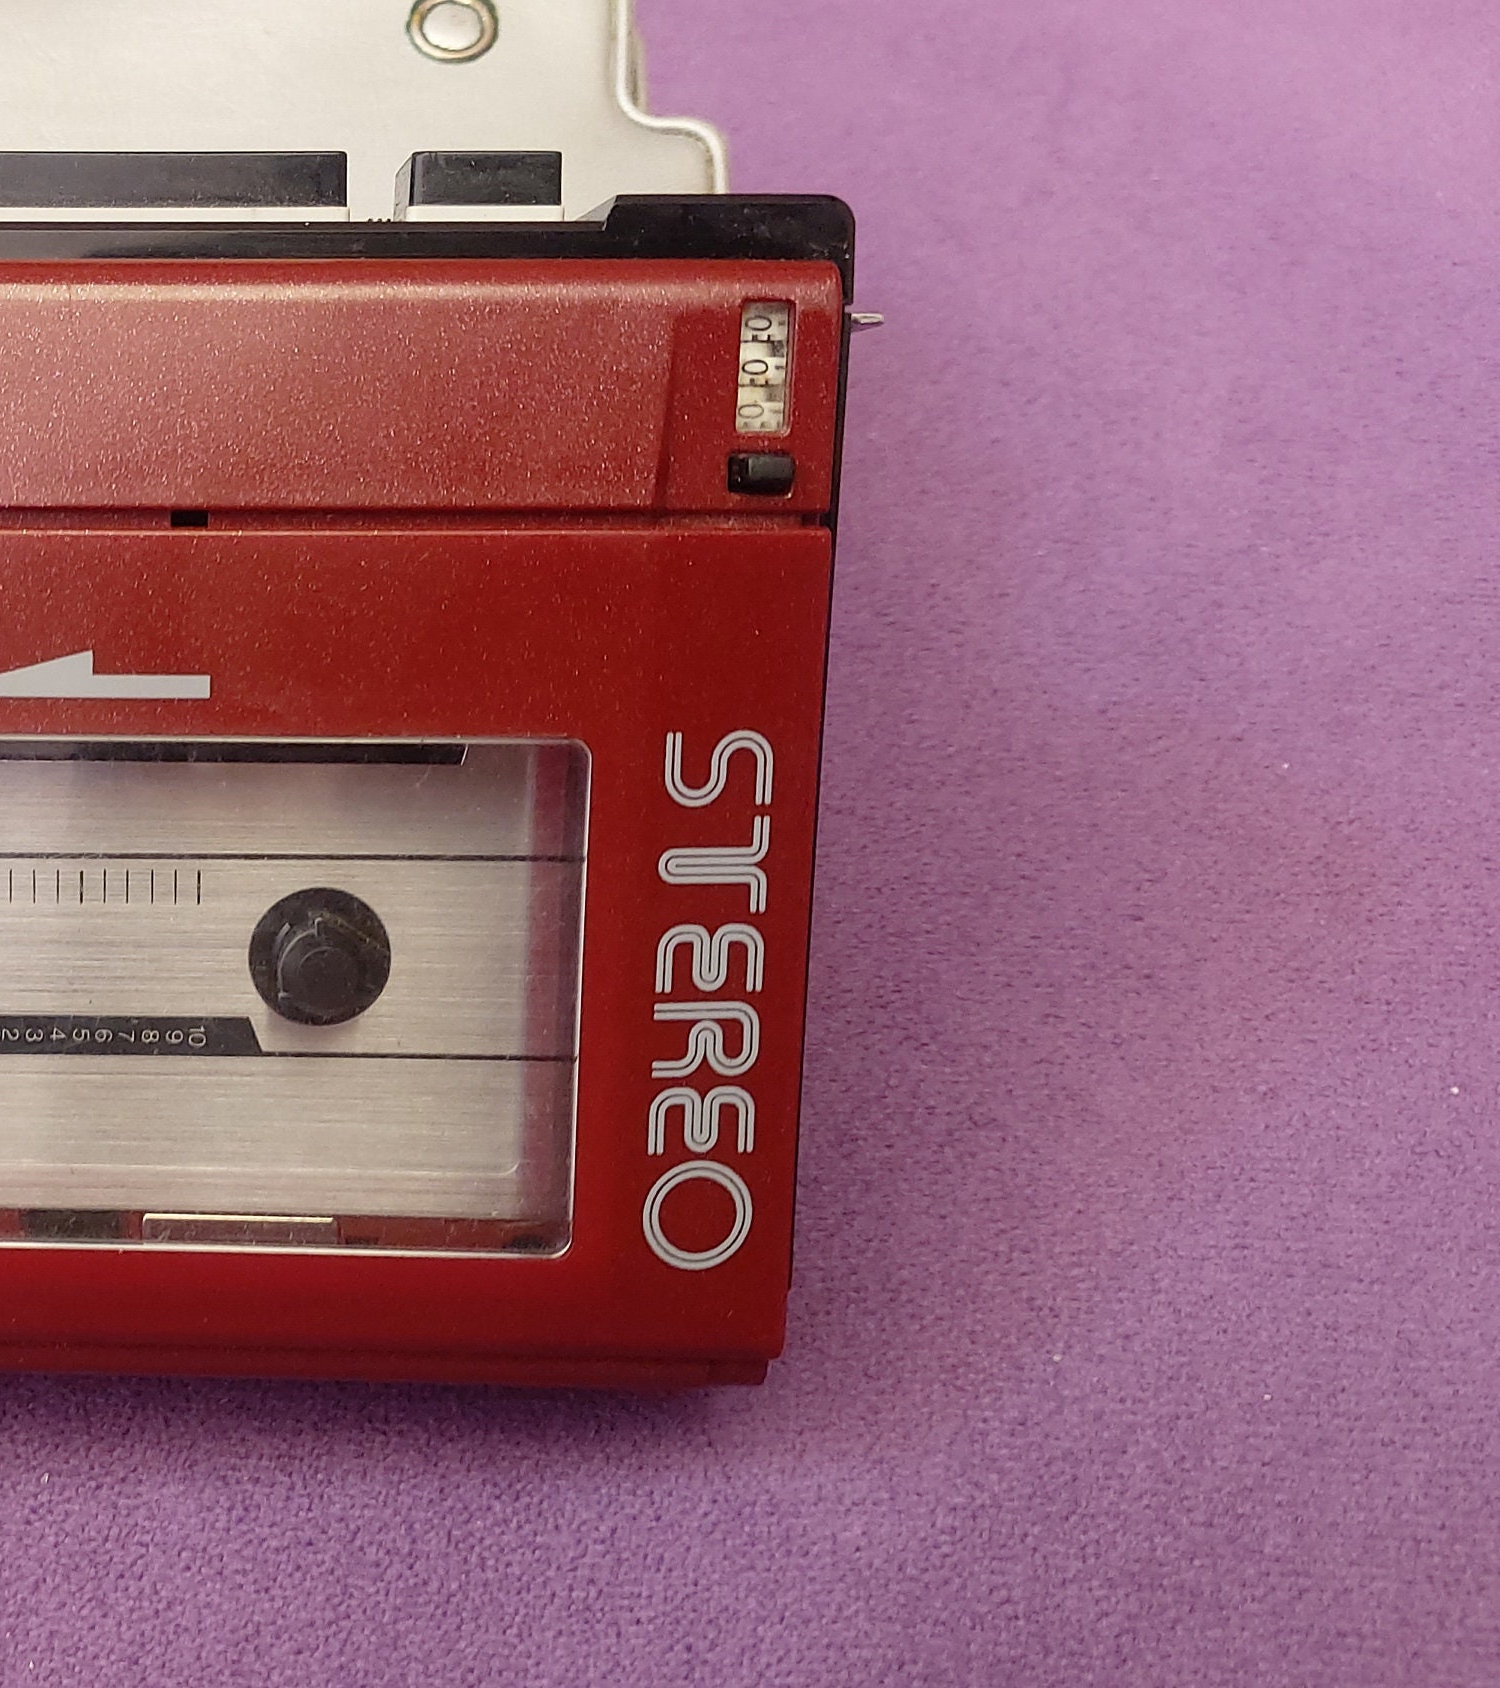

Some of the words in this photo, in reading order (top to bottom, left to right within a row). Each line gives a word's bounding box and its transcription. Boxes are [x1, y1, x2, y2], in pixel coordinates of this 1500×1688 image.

[1, 1027, 20, 1042] 2
[25, 1027, 44, 1043] 3
[49, 1027, 67, 1041] 4
[72, 1027, 90, 1042] 5
[94, 1028, 113, 1043] 6
[117, 1029, 135, 1043] 7
[141, 1028, 160, 1044] 8
[165, 1029, 184, 1045] 9
[187, 1025, 207, 1048] 10
[643, 729, 774, 1271] STEREO
